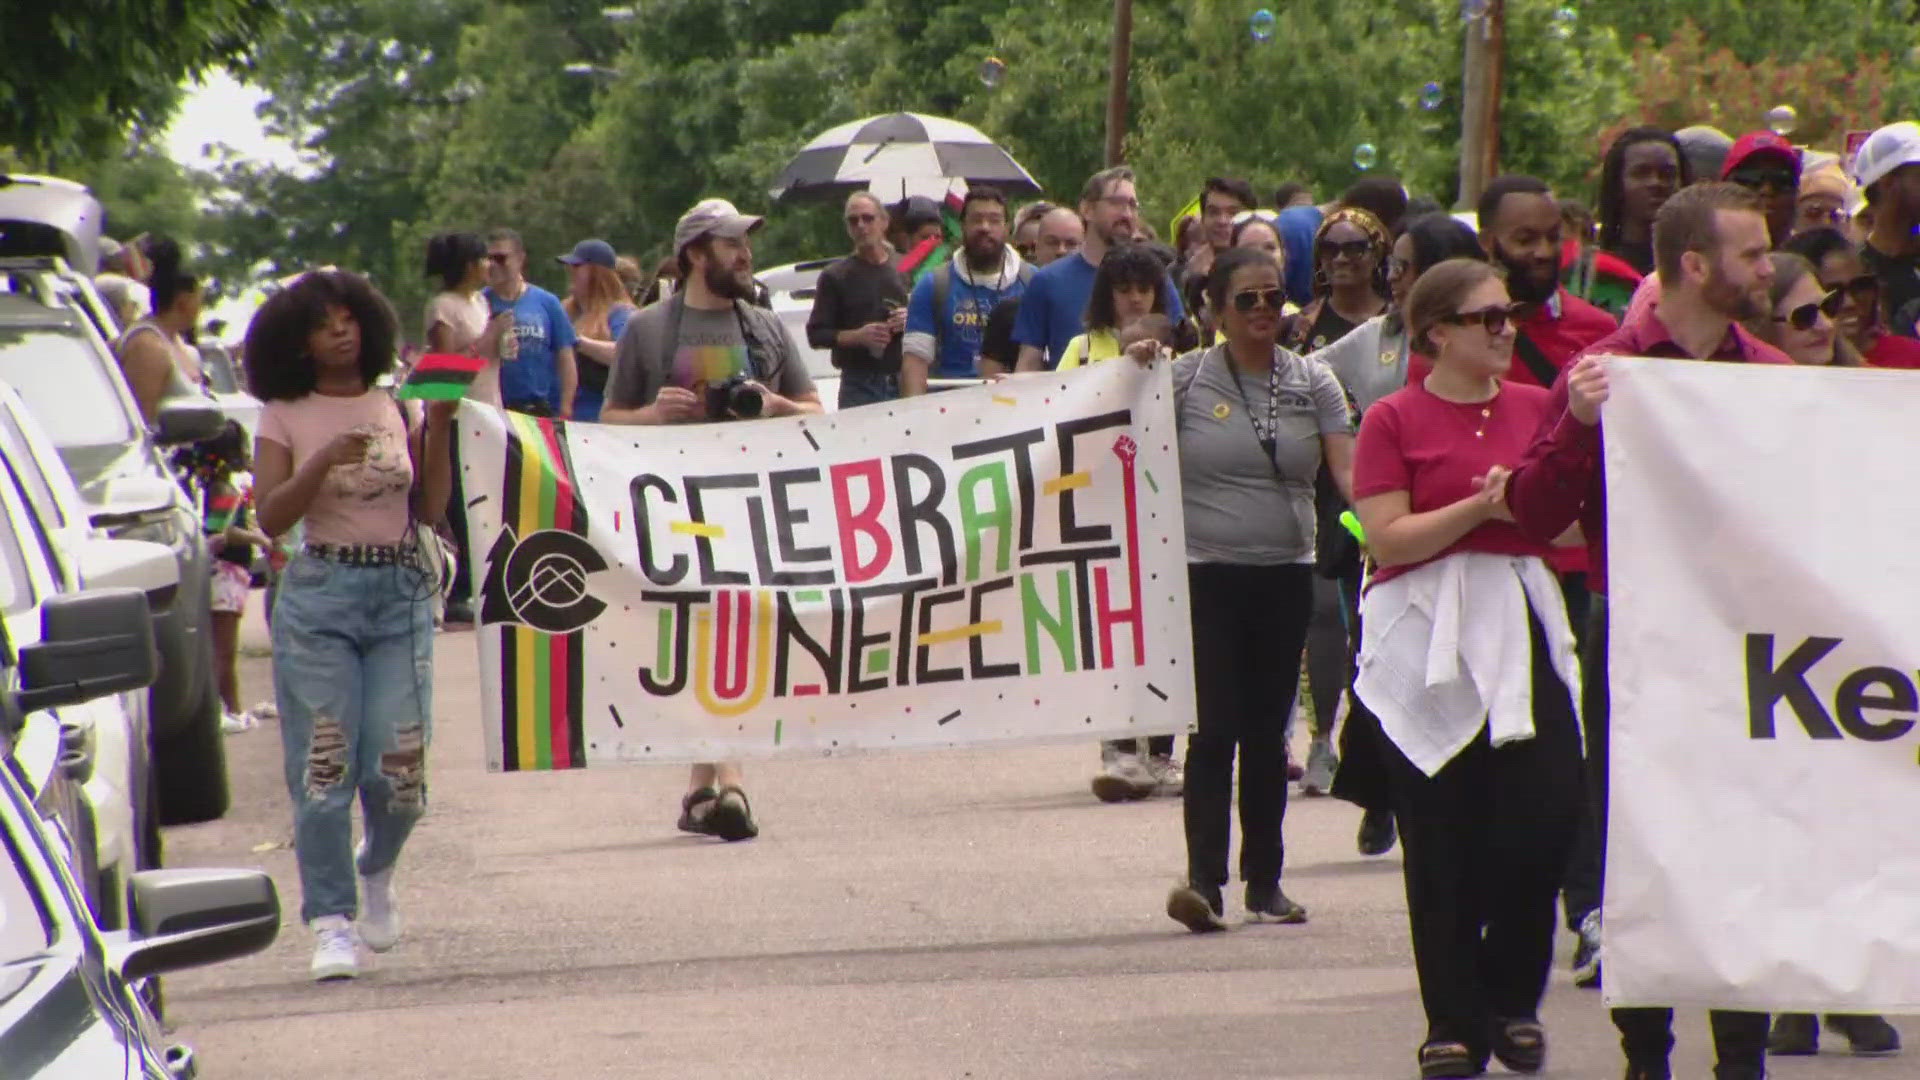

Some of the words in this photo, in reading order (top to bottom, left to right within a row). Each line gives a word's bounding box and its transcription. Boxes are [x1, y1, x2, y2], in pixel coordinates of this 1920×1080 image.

[629, 409, 1132, 586] CELEBRATE
[638, 436, 1145, 717] JUNETEENTH
[1745, 632, 1920, 765] Ke
